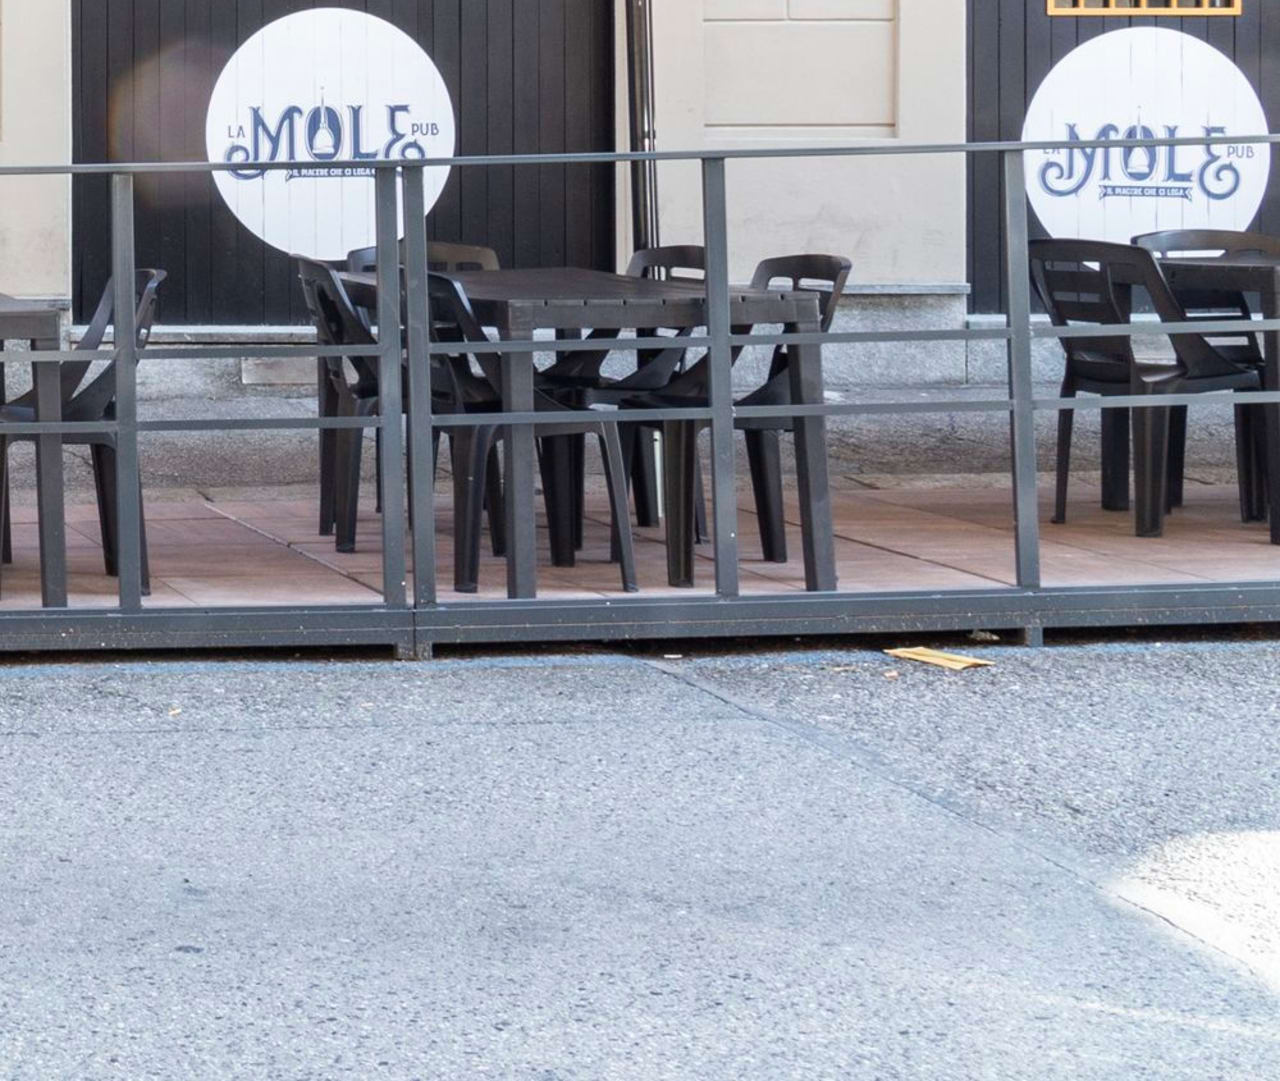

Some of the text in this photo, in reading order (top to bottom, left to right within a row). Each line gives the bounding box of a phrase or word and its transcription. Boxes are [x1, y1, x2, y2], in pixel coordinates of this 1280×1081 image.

[224, 104, 440, 181] LA MOLE PUB
[1038, 122, 1255, 201] MOLE PUB
